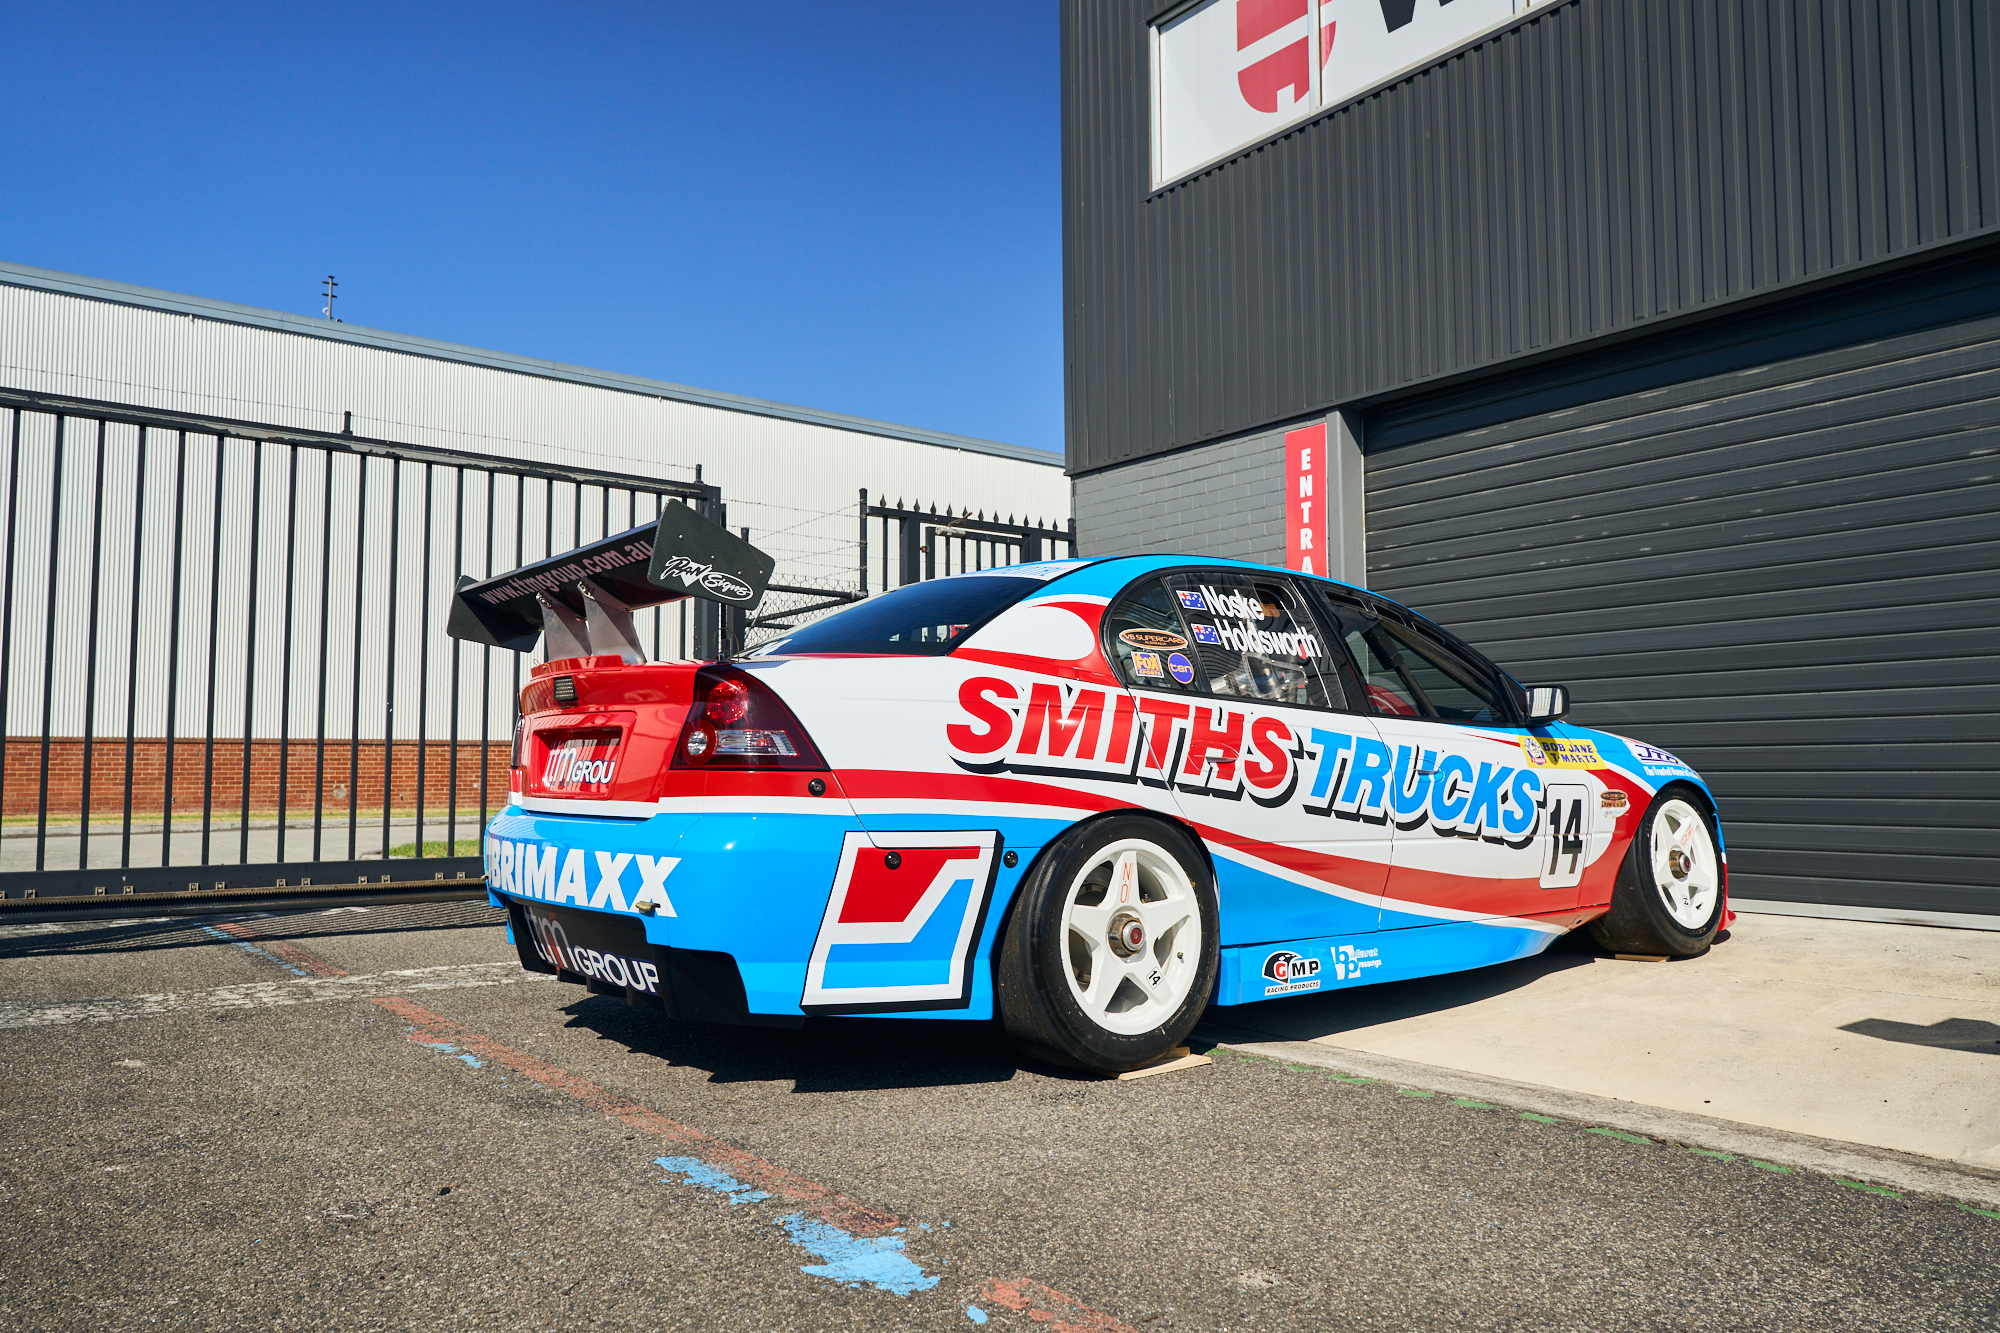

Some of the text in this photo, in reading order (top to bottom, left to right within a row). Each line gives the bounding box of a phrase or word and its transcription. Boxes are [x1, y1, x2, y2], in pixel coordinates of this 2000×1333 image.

[479, 540, 654, 605] www.ttmgroup.com.au
[704, 574, 751, 596] Signs
[1199, 585, 1265, 621] Noske
[1214, 618, 1322, 658] Holdsworth
[1134, 653, 1161, 671] FOX
[1169, 663, 1194, 674] ten
[946, 676, 1541, 834] SMITHS TRUCKS
[1541, 742, 1566, 752] BOB
[1568, 744, 1594, 754] JANE
[1549, 798, 1583, 876] 14
[1147, 969, 1161, 986] 14
[1275, 960, 1319, 978] GMP
[1266, 981, 1319, 994] RACING PRODUCTS
